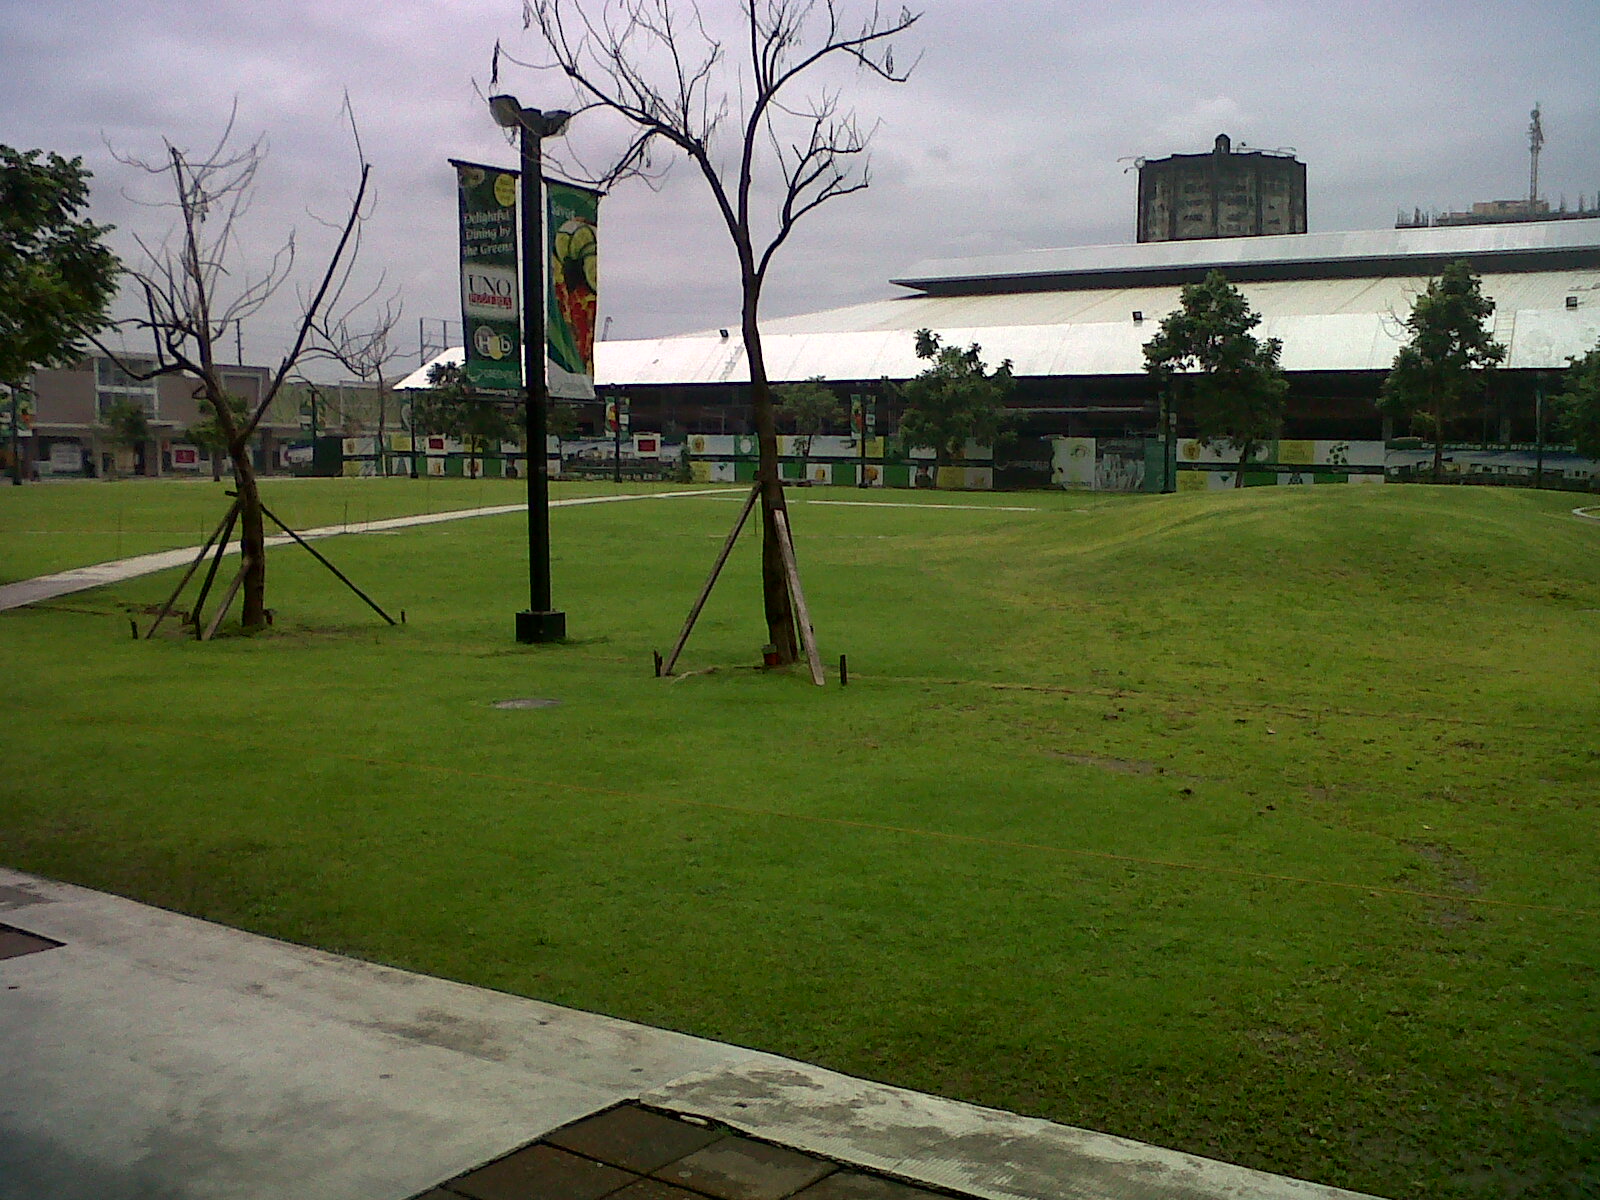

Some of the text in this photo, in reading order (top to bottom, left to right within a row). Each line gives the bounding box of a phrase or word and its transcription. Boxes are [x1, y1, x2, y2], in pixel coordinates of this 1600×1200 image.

[466, 225, 511, 240] Dining by
[468, 274, 511, 297] UNO
